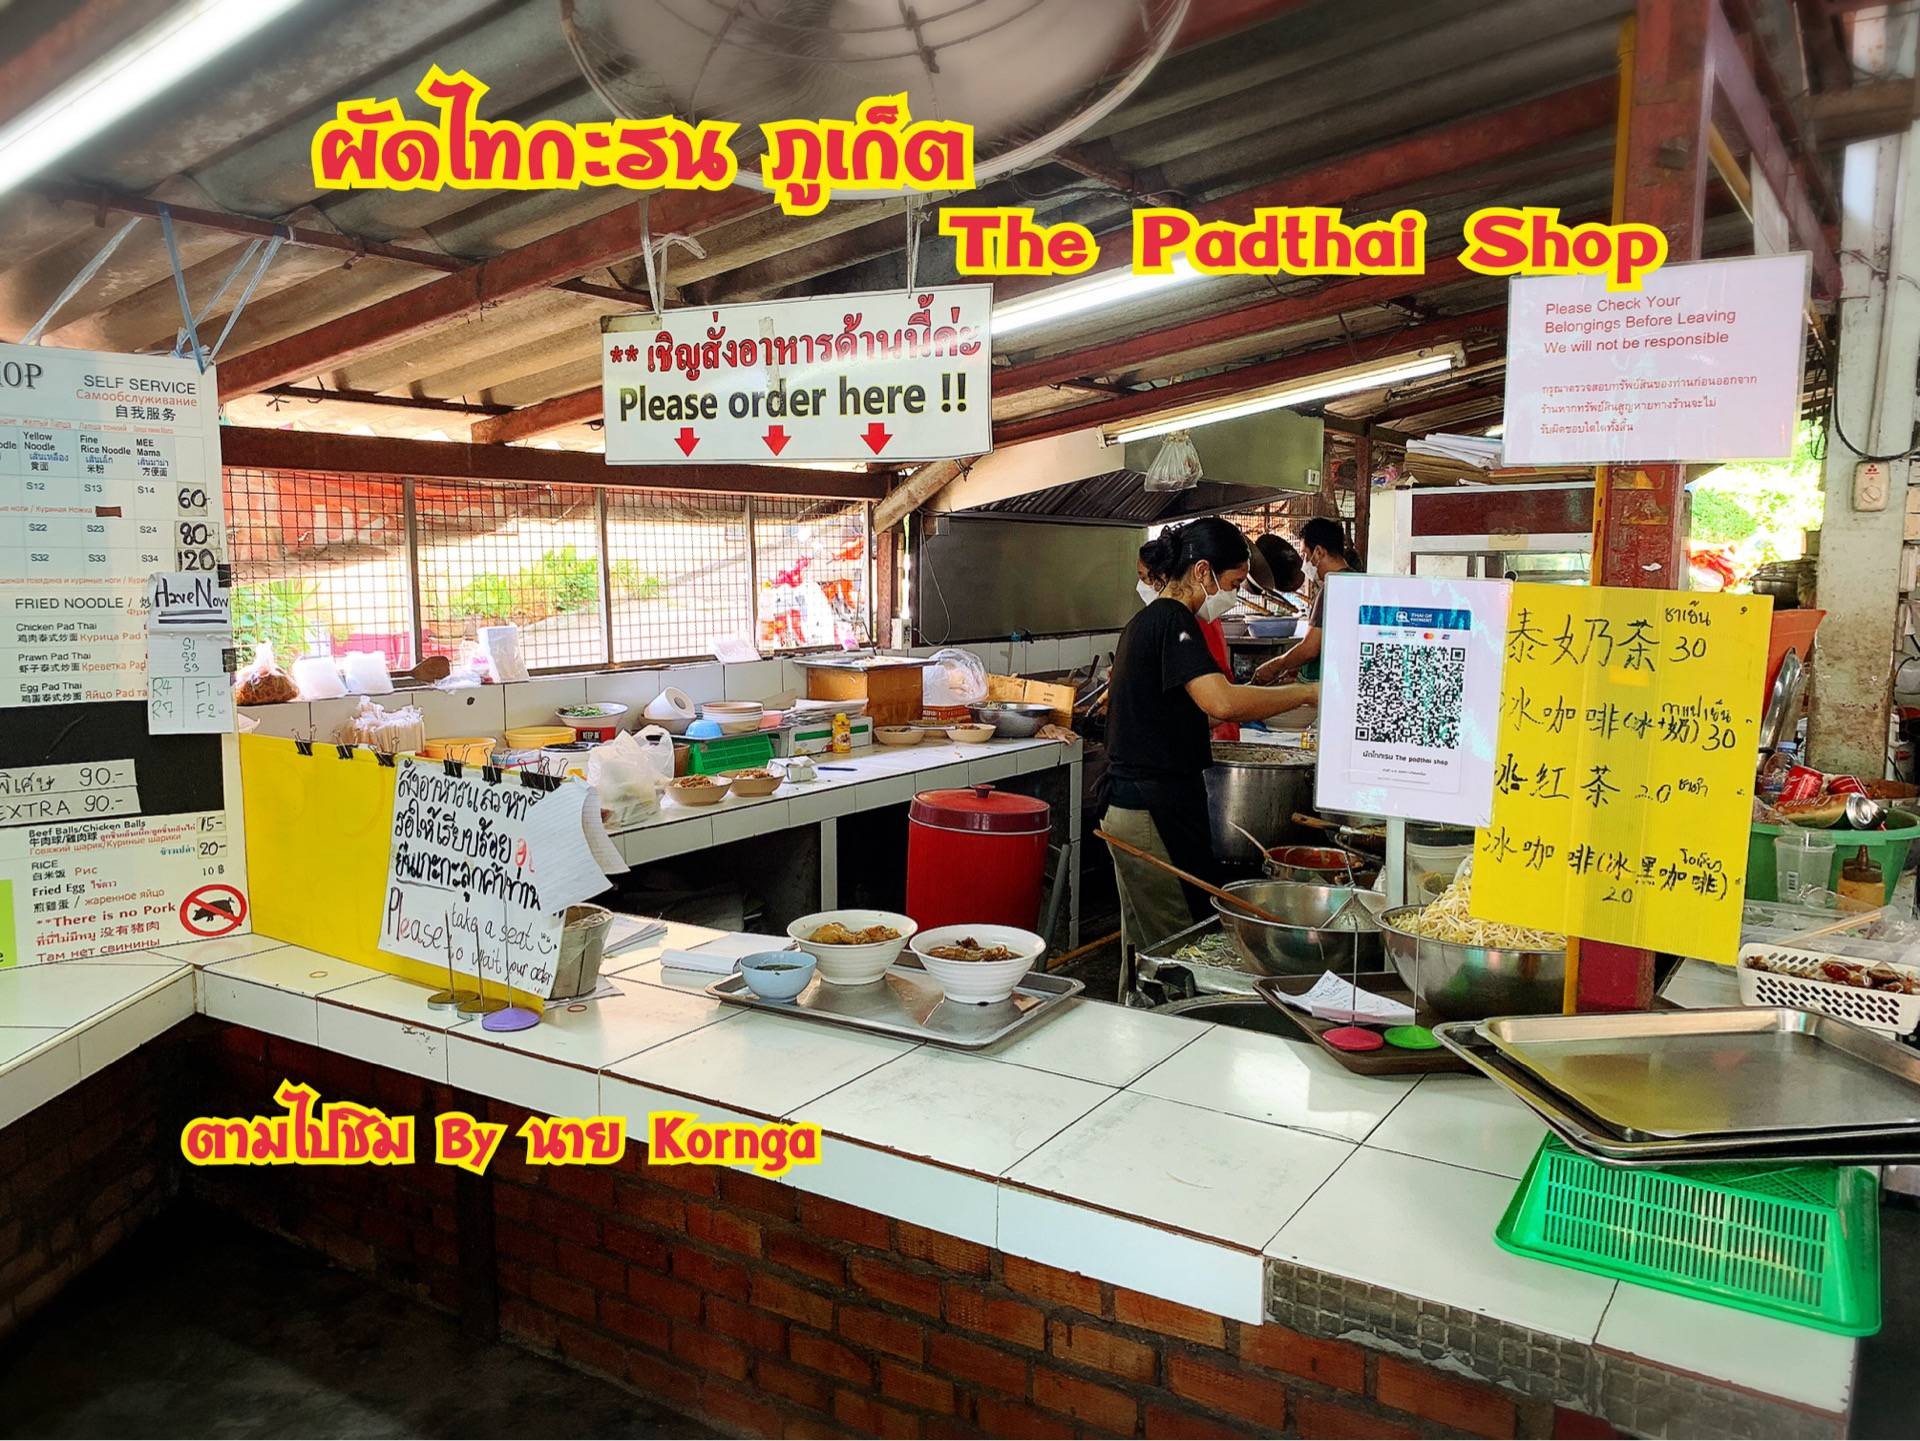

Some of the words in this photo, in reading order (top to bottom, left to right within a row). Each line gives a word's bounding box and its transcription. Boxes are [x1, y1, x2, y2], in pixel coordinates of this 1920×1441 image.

[1545, 303, 1592, 315] Please
[1596, 298, 1641, 312] Check
[1646, 296, 1681, 308] Your
[1544, 318, 1621, 334] Belongings
[1625, 314, 1673, 328] Before
[1677, 310, 1737, 325] Leaving
[646, 293, 982, 381] เชิญสั่งอาหารด้านนี้ค่ะ
[1544, 342, 1567, 353] We
[1570, 339, 1592, 352] will
[1596, 339, 1618, 351] not
[1622, 337, 1640, 349] be
[1644, 332, 1729, 349] responsible
[0, 360, 43, 390] OP
[84, 374, 124, 389] SELF
[129, 378, 197, 395] SERVICE
[76, 387, 198, 407] Самообслуживание
[619, 384, 718, 423] Please
[728, 376, 827, 418] order
[838, 375, 926, 416] here
[940, 372, 967, 414] !!
[115, 404, 176, 421] 自我服务
[23, 432, 53, 441] Yellow
[80, 434, 98, 444] Fine
[136, 438, 155, 447] MEE
[24, 442, 56, 451] Noodle
[80, 444, 100, 454] Rice
[101, 446, 132, 456] Noodle
[136, 448, 161, 457] Mama
[26, 481, 45, 491] S12
[84, 484, 103, 493] S13
[137, 486, 155, 494] S14
[28, 523, 48, 532] S22
[86, 524, 105, 533] S23
[139, 525, 157, 534] S24
[30, 553, 49, 562] S32
[88, 553, 106, 563] S33
[141, 554, 159, 563] S34
[155, 577, 194, 608] Have
[195, 577, 229, 608] Now
[15, 598, 60, 609] FRIED
[64, 597, 124, 609] NOODLE
[16, 623, 54, 632] Chicken
[56, 622, 75, 631] Pad
[77, 621, 97, 630] Thai
[182, 637, 196, 651] S1
[1668, 635, 1707, 663] 30
[18, 653, 48, 661] Prawn
[50, 652, 69, 661] Pad
[71, 651, 91, 660] Thai
[181, 651, 197, 662] S2
[183, 662, 200, 673] S3
[20, 683, 39, 693] Egg
[41, 682, 60, 691] Pad
[62, 681, 82, 690] Thai
[1701, 723, 1736, 751] 30
[29, 827, 52, 838] Beef
[55, 822, 121, 836] Balls/Chicken
[124, 819, 146, 829] Balls
[31, 859, 58, 870] RICE
[203, 866, 215, 876] 10
[32, 883, 61, 896] Fried
[66, 883, 85, 895] Egg
[1601, 886, 1633, 903] 20
[84, 892, 137, 906] жаренное
[139, 887, 165, 898] яйцо
[102, 910, 113, 921] is
[119, 908, 137, 918] no
[143, 901, 177, 915] Pork
[387, 886, 443, 949] Please
[99, 920, 160, 938] 没有猪肉
[451, 902, 478, 933] take
[484, 920, 497, 939] a
[499, 921, 534, 951] seat
[36, 950, 65, 963] Там
[71, 946, 96, 958] нет
[99, 938, 161, 954] свинины
